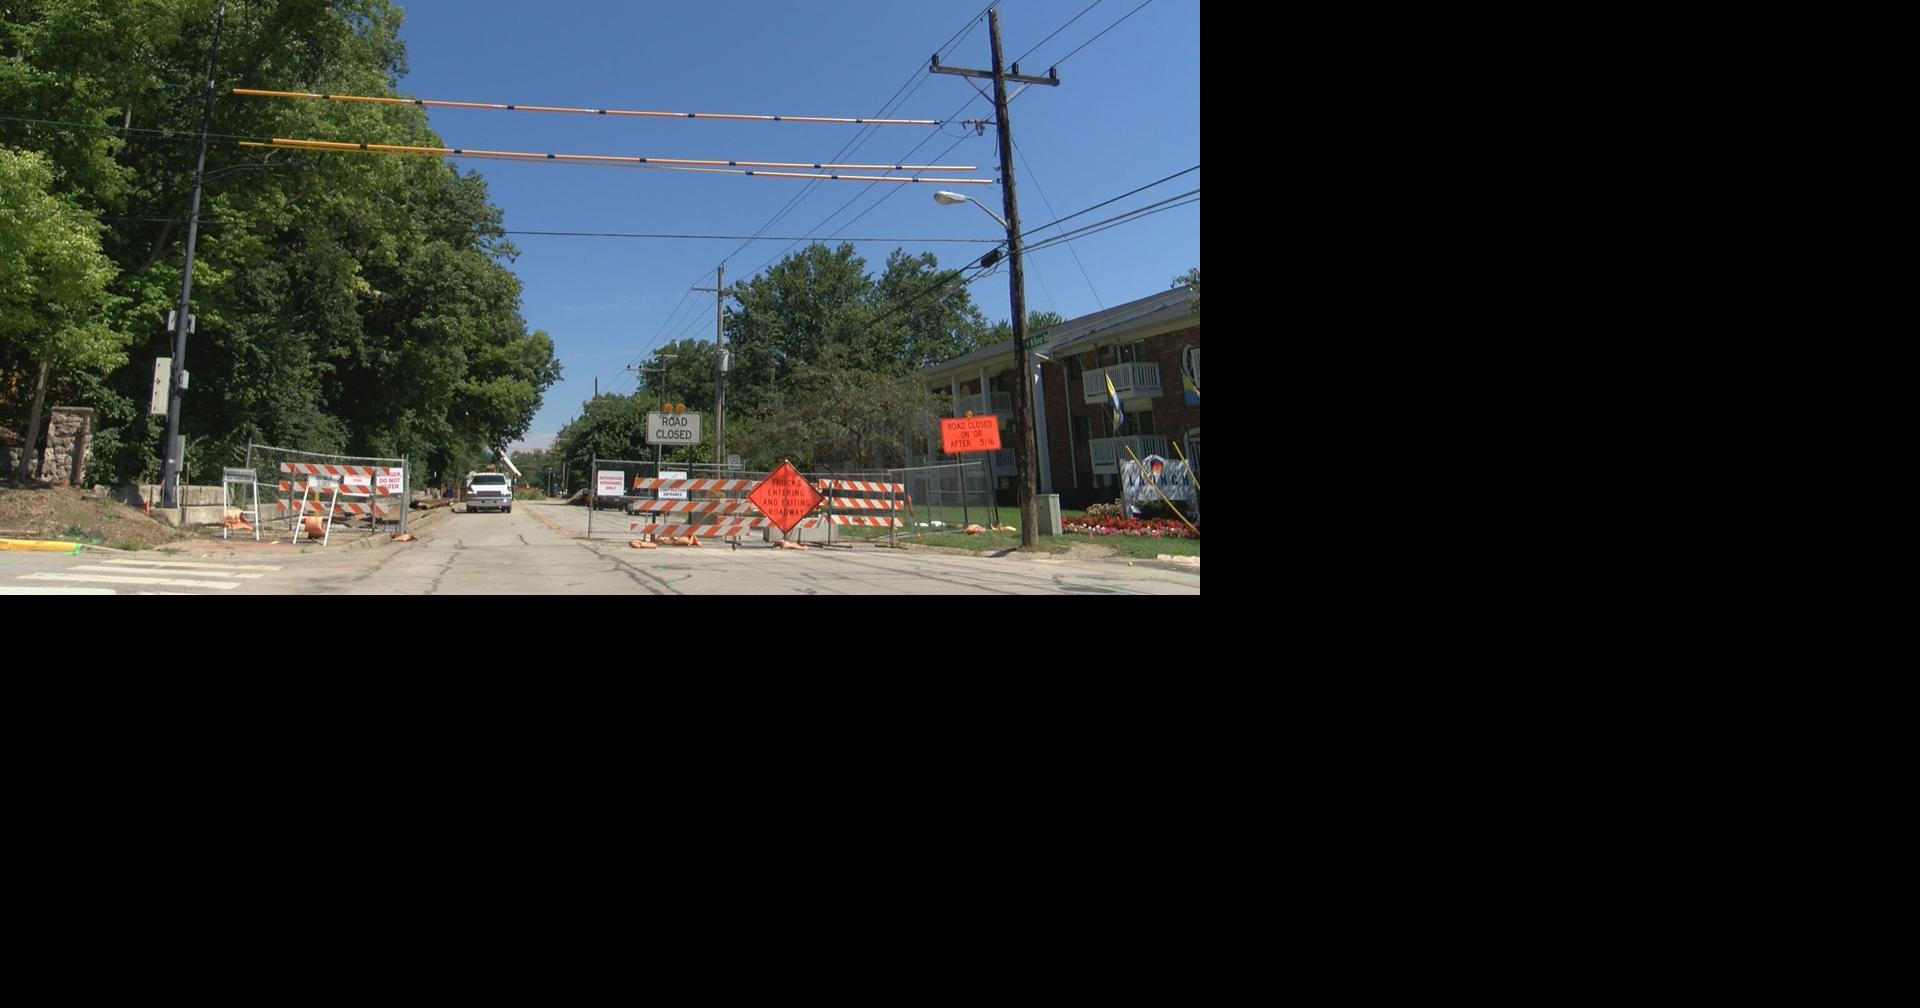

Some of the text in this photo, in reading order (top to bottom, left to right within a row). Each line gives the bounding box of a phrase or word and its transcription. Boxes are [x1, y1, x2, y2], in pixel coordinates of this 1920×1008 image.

[661, 416, 688, 426] ROAD
[947, 420, 992, 430] ROAD CLOSED
[655, 429, 692, 440] CLOSED
[960, 430, 970, 438] ON
[950, 440, 970, 448] AFTER
[772, 479, 801, 487] TRUCKS
[767, 488, 805, 497] ENTERING
[781, 499, 810, 507] EXITING
[768, 508, 804, 516] ROADWAY
